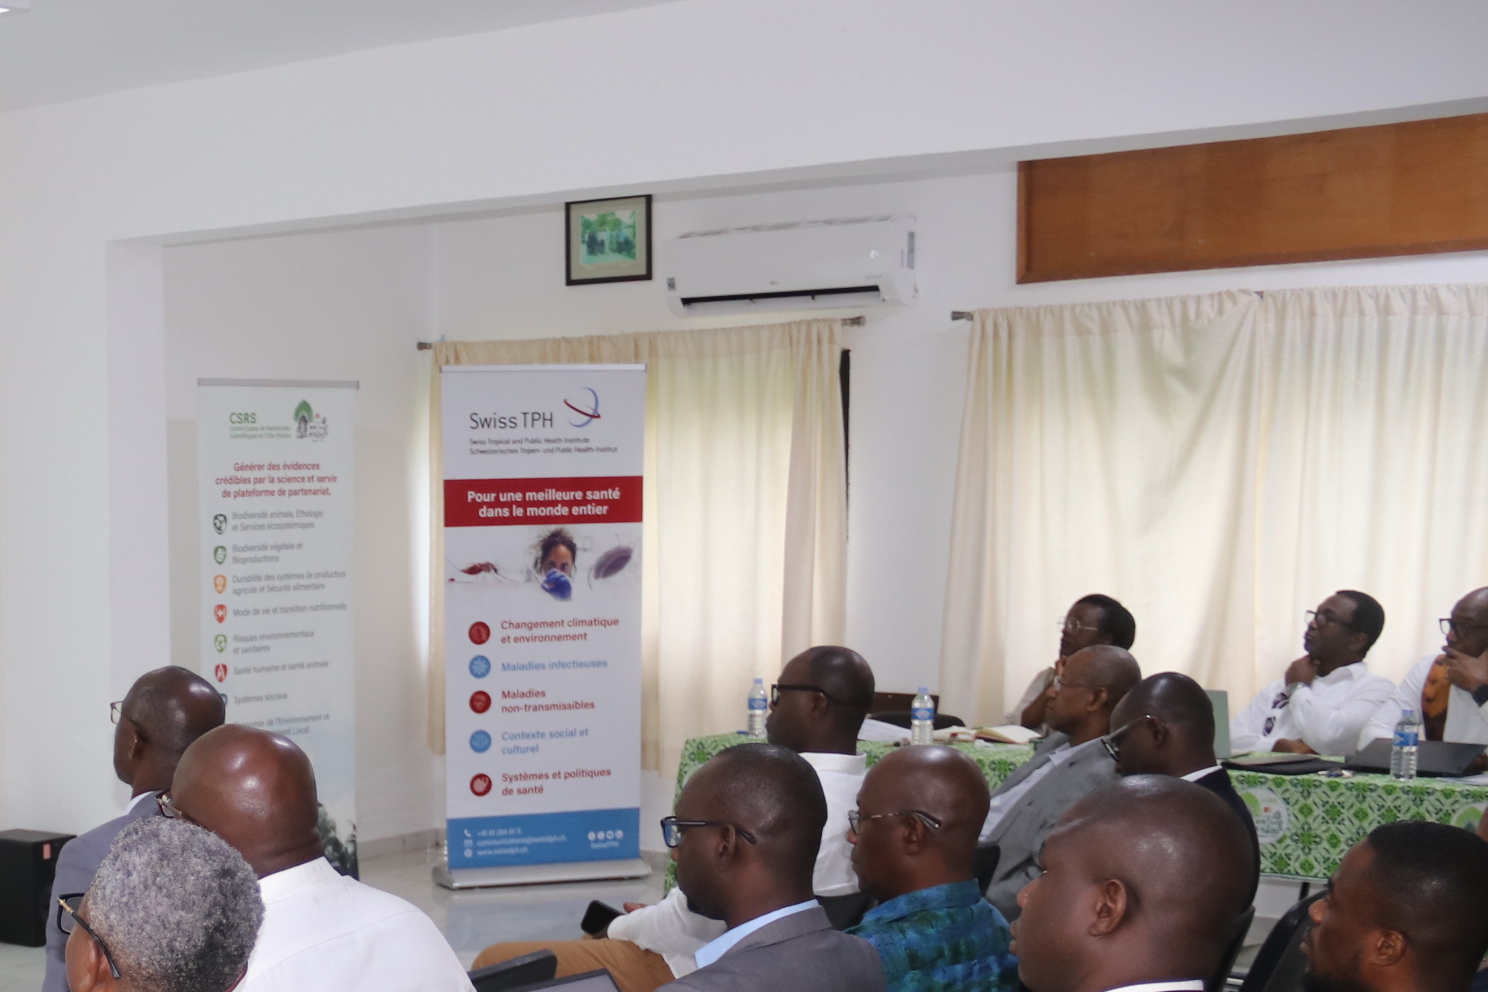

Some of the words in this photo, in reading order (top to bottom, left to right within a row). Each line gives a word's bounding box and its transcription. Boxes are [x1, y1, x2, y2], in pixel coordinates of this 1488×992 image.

[229, 412, 256, 424] CSRS
[469, 412, 517, 430] Swiss
[521, 411, 554, 428] TPH
[469, 437, 486, 445] Swiss
[487, 437, 510, 446] Tropical
[511, 437, 522, 445] and
[542, 446, 554, 454] und
[555, 446, 572, 454] Public
[233, 462, 264, 472] Générer
[266, 462, 280, 471] des
[282, 461, 320, 471] évidences
[215, 475, 251, 485] crédibles
[253, 476, 266, 486] par
[277, 475, 305, 483] science
[307, 475, 314, 483] et
[316, 473, 337, 483] servir
[221, 489, 231, 498] de
[233, 488, 275, 499] plateforme
[277, 487, 286, 496] de
[288, 487, 331, 498] partenariat.
[467, 490, 496, 503] Pour
[499, 491, 522, 502] une
[525, 488, 583, 501] meilleure
[585, 487, 620, 500] santé
[232, 511, 268, 520] Biodiversité
[478, 506, 510, 518] dans
[512, 505, 523, 517] le
[526, 503, 569, 517] monde
[571, 503, 609, 515] entier
[239, 522, 265, 531] Services
[232, 554, 279, 565] Bioproductions
[276, 572, 304, 582] systèmes
[314, 570, 346, 580] production
[232, 585, 257, 596] agricole
[292, 582, 325, 591] alimentaire
[232, 608, 251, 617] Mode
[279, 604, 308, 614] transition
[309, 602, 347, 611] nutritionnelle
[500, 618, 565, 631] Changement
[567, 617, 619, 629] climatique
[501, 635, 511, 644] et
[513, 632, 588, 643] environnement
[233, 665, 251, 676] Santé
[252, 664, 279, 674] humaine
[306, 660, 329, 669] animale
[501, 661, 546, 672] Maladies
[548, 659, 608, 670] infectieuses
[501, 688, 546, 699] Maladies
[501, 700, 595, 713] non-transmissibles
[501, 730, 546, 741] Contexte
[548, 729, 577, 739] social
[579, 728, 589, 738] et
[501, 744, 539, 755] culturel
[501, 771, 549, 784] Systèmes
[551, 770, 561, 780] et
[563, 767, 611, 780] politiques
[501, 786, 513, 796] de
[516, 784, 544, 795] santé
